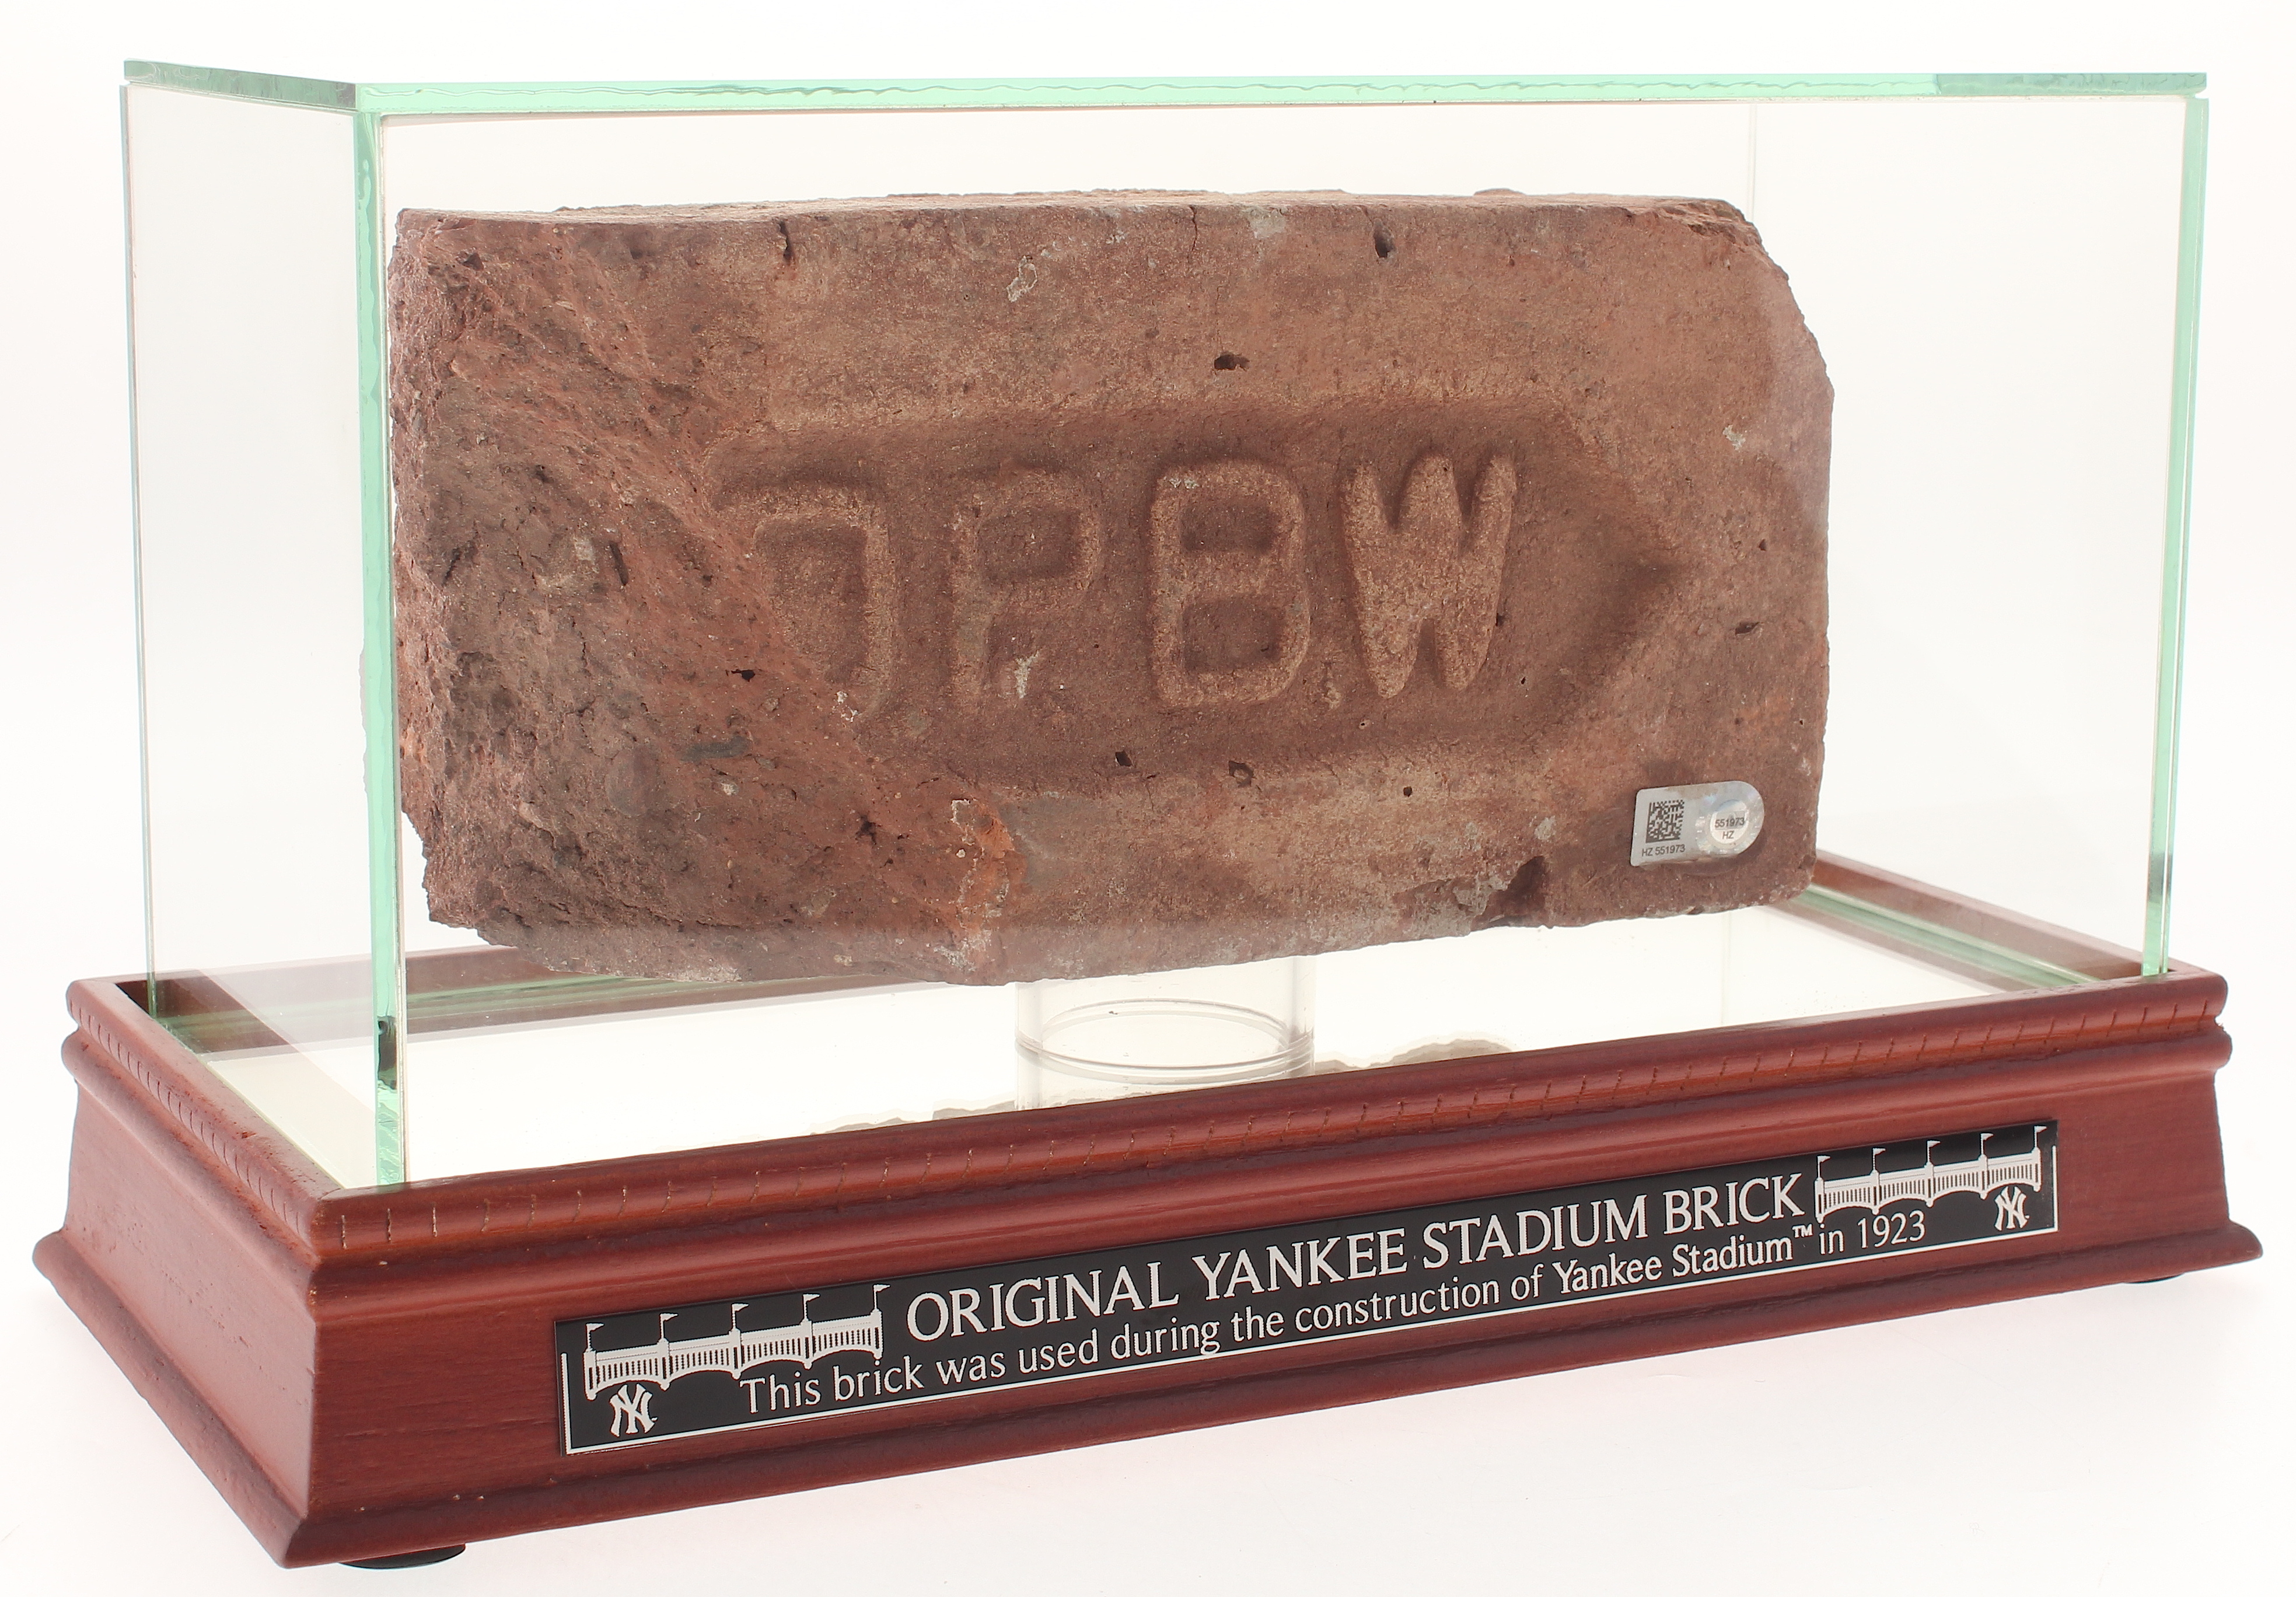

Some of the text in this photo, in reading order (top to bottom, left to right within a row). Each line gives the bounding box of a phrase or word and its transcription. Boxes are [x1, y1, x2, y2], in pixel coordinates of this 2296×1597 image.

[1715, 817, 1745, 828] 551973
[1722, 830, 1735, 839] HZ
[1641, 844, 1685, 857] HZ 551973
[907, 1172, 1805, 1341] ORIGINAL YANKEE STADIUM BRICK
[739, 1371, 820, 1414] This
[833, 1354, 925, 1402] brick
[935, 1352, 1007, 1385] was
[1018, 1328, 1099, 1374] used
[1110, 1316, 1221, 1361] during
[1231, 1305, 1285, 1343] the
[1295, 1275, 1500, 1333] construction
[1511, 1263, 1544, 1301] of
[1551, 1252, 1662, 1294] Yankee
[1819, 1223, 1844, 1255] in
[1857, 1210, 1926, 1249] 1923
